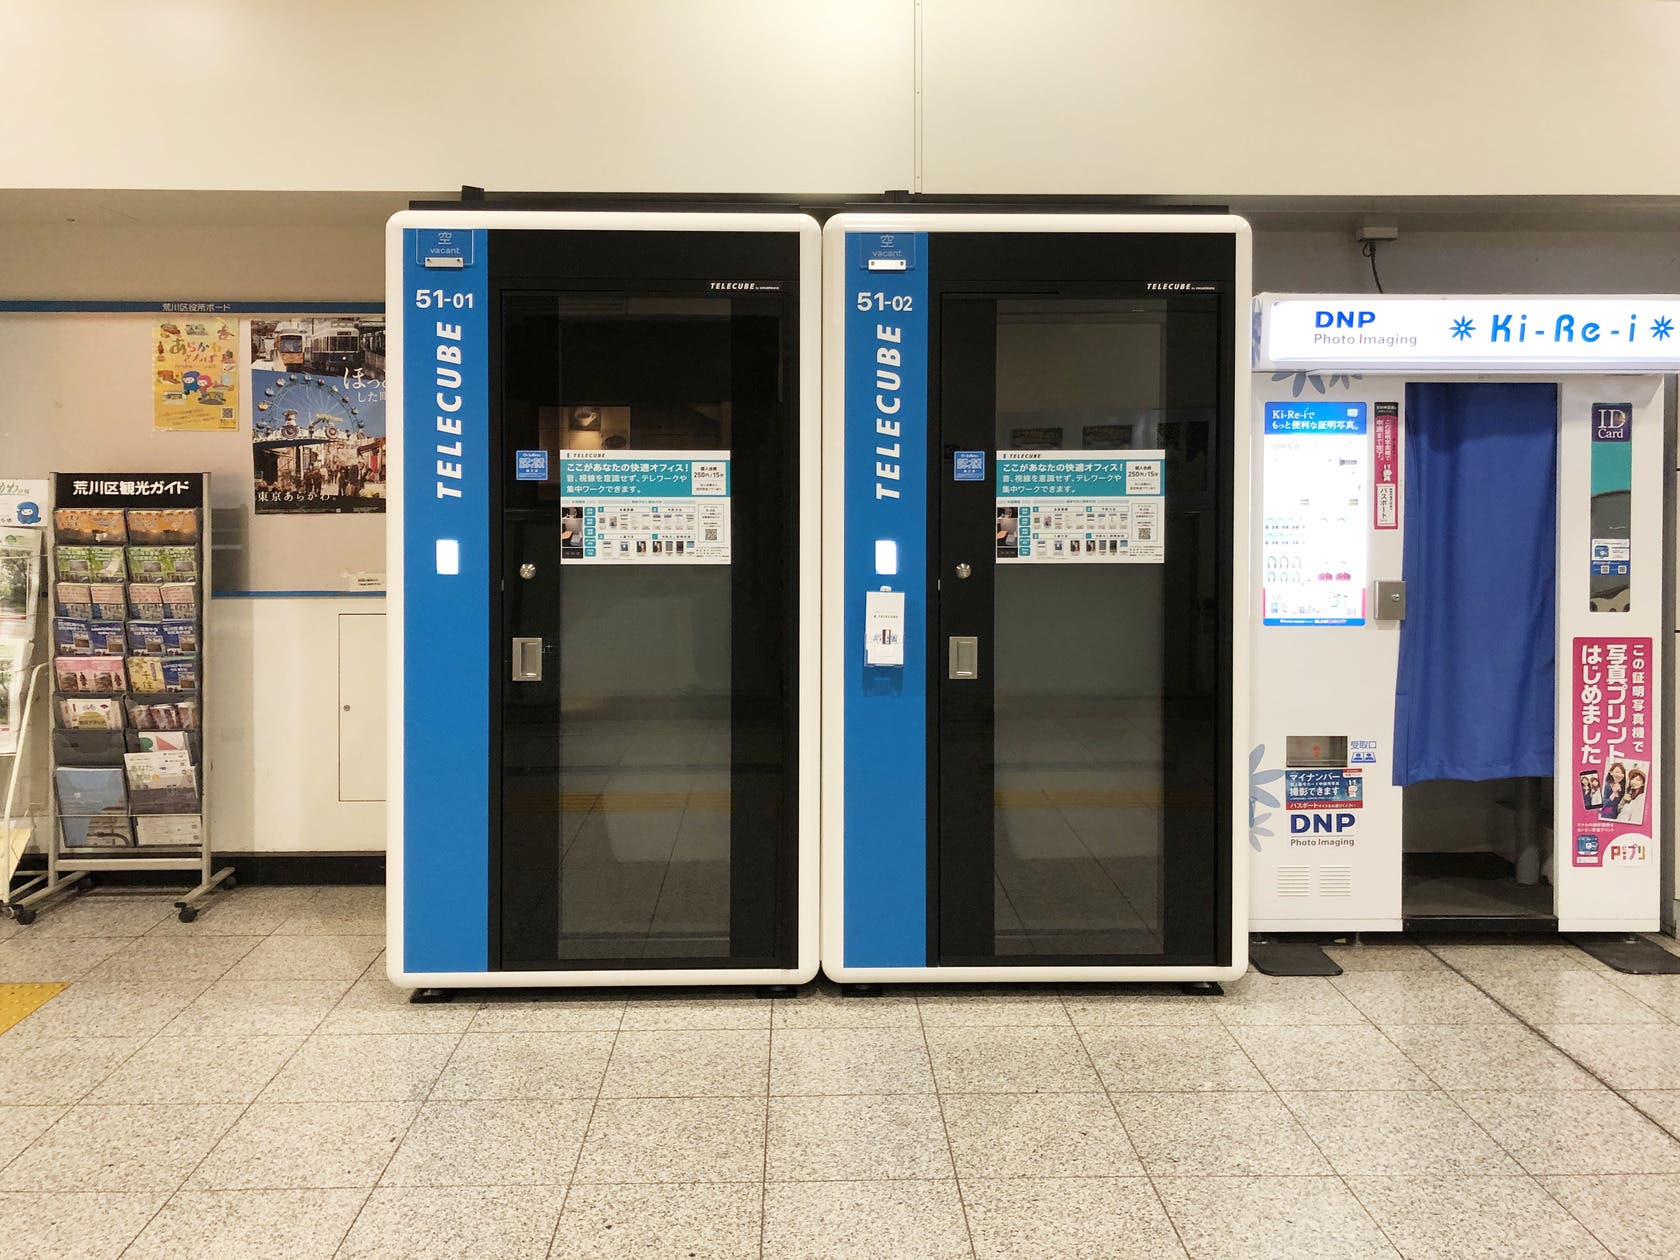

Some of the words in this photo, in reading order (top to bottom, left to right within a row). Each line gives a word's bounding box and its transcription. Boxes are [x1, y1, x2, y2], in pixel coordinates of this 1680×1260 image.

[438, 231, 452, 245] 空
[880, 234, 894, 248] 空
[710, 282, 755, 290] TELECUBE
[415, 289, 473, 309] 51-01
[857, 292, 913, 312] 51-02
[161, 303, 232, 312] 荒川区役所ボード
[1315, 311, 1376, 328] DNP
[1313, 333, 1355, 345] Photo
[1359, 332, 1417, 348] Imaging
[343, 367, 386, 390] ほっ
[436, 321, 463, 499] TELECUBE
[876, 324, 901, 500] TELECUBE
[1272, 420, 1359, 431] もっと便利な証明写真。
[1597, 409, 1626, 429] ID
[1598, 428, 1625, 439] Card
[72, 480, 190, 496] 荒川区観光ガイド
[1580, 644, 1602, 764] はじめました
[1606, 644, 1628, 762] 写真プリント
[1631, 644, 1645, 753] この証明写真機で
[1350, 740, 1376, 749] 受取口
[1289, 772, 1341, 782] マイナンバー
[1289, 786, 1341, 797] 撮影できます
[1290, 813, 1356, 833] DNP
[1290, 838, 1317, 847] Photo
[1318, 838, 1355, 848] Imaging
